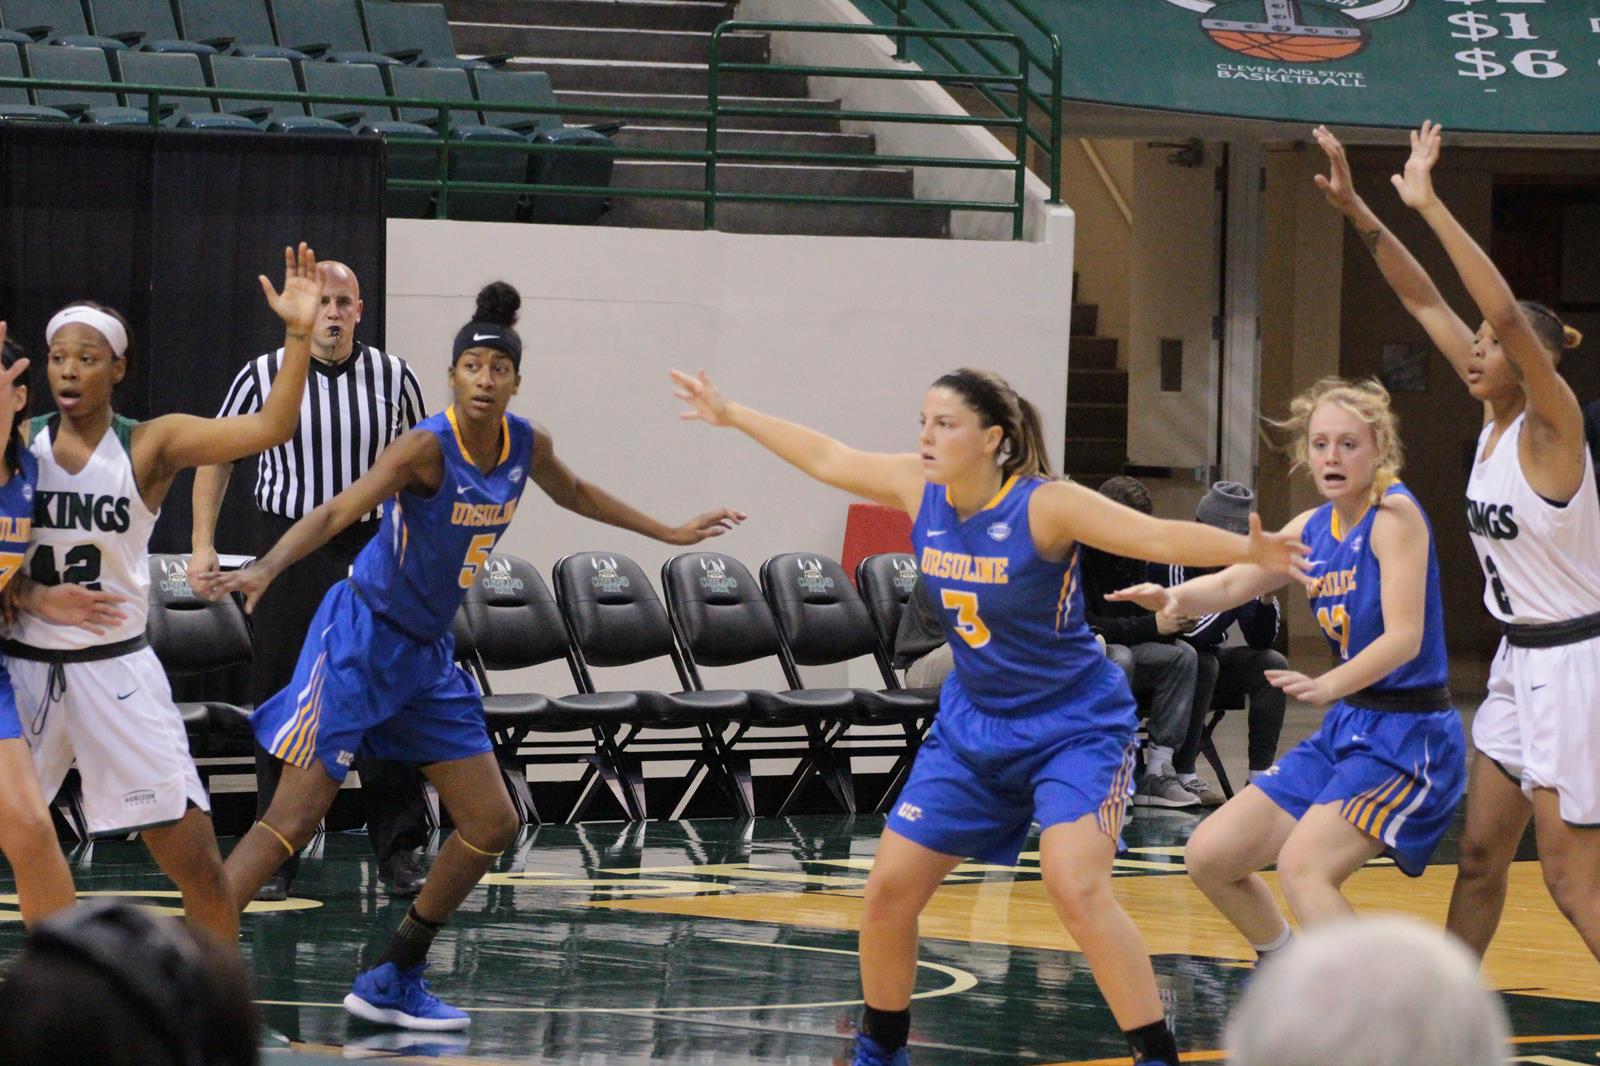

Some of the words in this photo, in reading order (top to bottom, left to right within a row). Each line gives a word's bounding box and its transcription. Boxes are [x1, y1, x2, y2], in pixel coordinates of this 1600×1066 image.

[1447, 10, 1539, 42] $1
[1216, 63, 1314, 76] CLEVELAND
[1317, 70, 1365, 79] STATE
[1217, 70, 1367, 88] BASKETBALL
[1454, 47, 1568, 80] $6
[458, 533, 496, 589] 5
[921, 546, 1008, 584] URSULINE
[940, 588, 991, 649] 3
